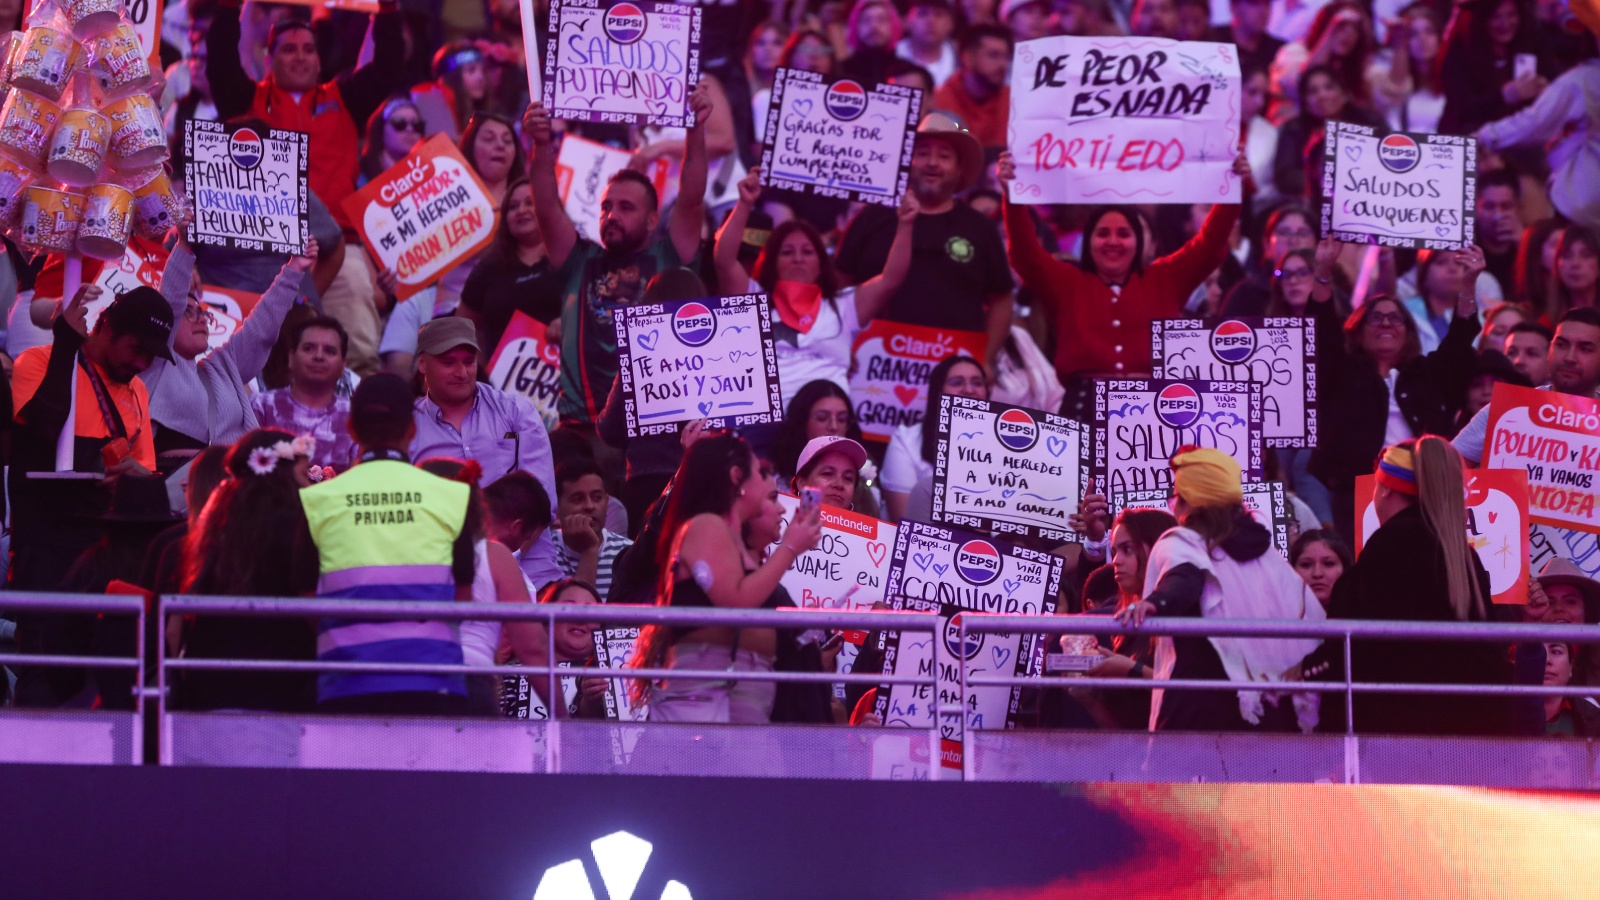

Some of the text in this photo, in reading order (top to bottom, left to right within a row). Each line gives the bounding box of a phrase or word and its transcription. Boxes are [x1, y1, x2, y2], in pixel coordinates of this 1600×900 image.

[655, 4, 690, 14] PEPSI
[608, 18, 642, 28] PEPSI
[691, 8, 702, 43] PEPSI
[546, 39, 556, 75] PEPSI
[567, 34, 683, 74] SALUDOS
[689, 50, 699, 85] PEPSI
[1029, 54, 1070, 91] DE
[1080, 49, 1168, 87] PEOR
[829, 93, 863, 106] PEPSI
[555, 109, 637, 123] PEPSI PEPSI
[195, 121, 298, 141] PEPSI PEPSI
[1338, 123, 1464, 145] PEPSI PEPSI
[232, 143, 259, 154] PEPSI
[300, 134, 308, 170] PEPSI
[868, 151, 890, 163] DE
[1116, 138, 1185, 172] EDO
[1323, 122, 1336, 197] PEPSI PEPSI
[1382, 147, 1416, 157] PEPSI
[380, 167, 424, 203] Claro
[1344, 167, 1440, 198] SALUDOS
[1465, 139, 1476, 210] PEPSI PEPSI
[390, 171, 454, 221] EL AMOR
[380, 185, 470, 250] DE MI HERIDA
[198, 235, 300, 254] PEPSI PEPSI PEPSI
[1379, 237, 1461, 250] PEPSI PEPSI
[627, 295, 756, 316] PEPSI PEPSI
[677, 318, 711, 329] PEPSI
[1165, 318, 1302, 329] PEPSI PEPSI
[890, 334, 944, 358] Claro
[1153, 321, 1161, 359] PEPSI
[1215, 337, 1251, 346] PEPSI
[633, 355, 704, 378] TE AMO
[758, 295, 782, 421] PEPSI PEPSI PEPSI
[614, 309, 637, 437] PEPSI PEPSI PEPSI
[867, 356, 930, 385] RANCA
[695, 376, 706, 396] Y
[1109, 381, 1248, 392] PEPSI PEPSI
[1306, 318, 1316, 447] PEPSI PEPSI PEPSI
[1160, 401, 1197, 409] PEPSI
[1214, 394, 1237, 403] VIÑA
[640, 414, 771, 436] PEPSI PEPSI
[954, 397, 1079, 430] PEPSI PEPSI
[1096, 382, 1105, 467] PEPSI PEPSI
[1539, 404, 1599, 429] Claro
[1000, 422, 1034, 436] PEPSI
[1251, 384, 1260, 469] PEPSI PEPSI
[1081, 424, 1090, 460] PEPSI
[1266, 438, 1305, 448] PEPSI
[1494, 428, 1568, 463] POLVITO
[933, 396, 950, 521] PEPSI PEPSI PEPSI
[958, 446, 992, 464] VILLA
[966, 470, 1028, 489] A VIÑA
[1527, 464, 1593, 488] YA VAMOS
[346, 492, 422, 507] SEGURIDAD
[954, 492, 969, 504] TE
[974, 498, 1006, 508] AMO
[1128, 490, 1167, 500] PEPSI
[1273, 483, 1284, 517] PEPSI
[355, 509, 414, 525] PRIVADA
[820, 511, 873, 534] Santander
[945, 513, 1076, 542] PEPSI PEPSI PEPSI
[895, 521, 910, 560] PEPSI
[913, 523, 1051, 563] PEPSI PEPSI
[960, 554, 997, 569] PEPSI
[1017, 562, 1042, 576] VIÑA
[1016, 575, 1041, 584] 2025
[1048, 557, 1063, 596] PEPSI
[906, 598, 942, 613] PEPSI
[606, 628, 640, 638] PEPSI
